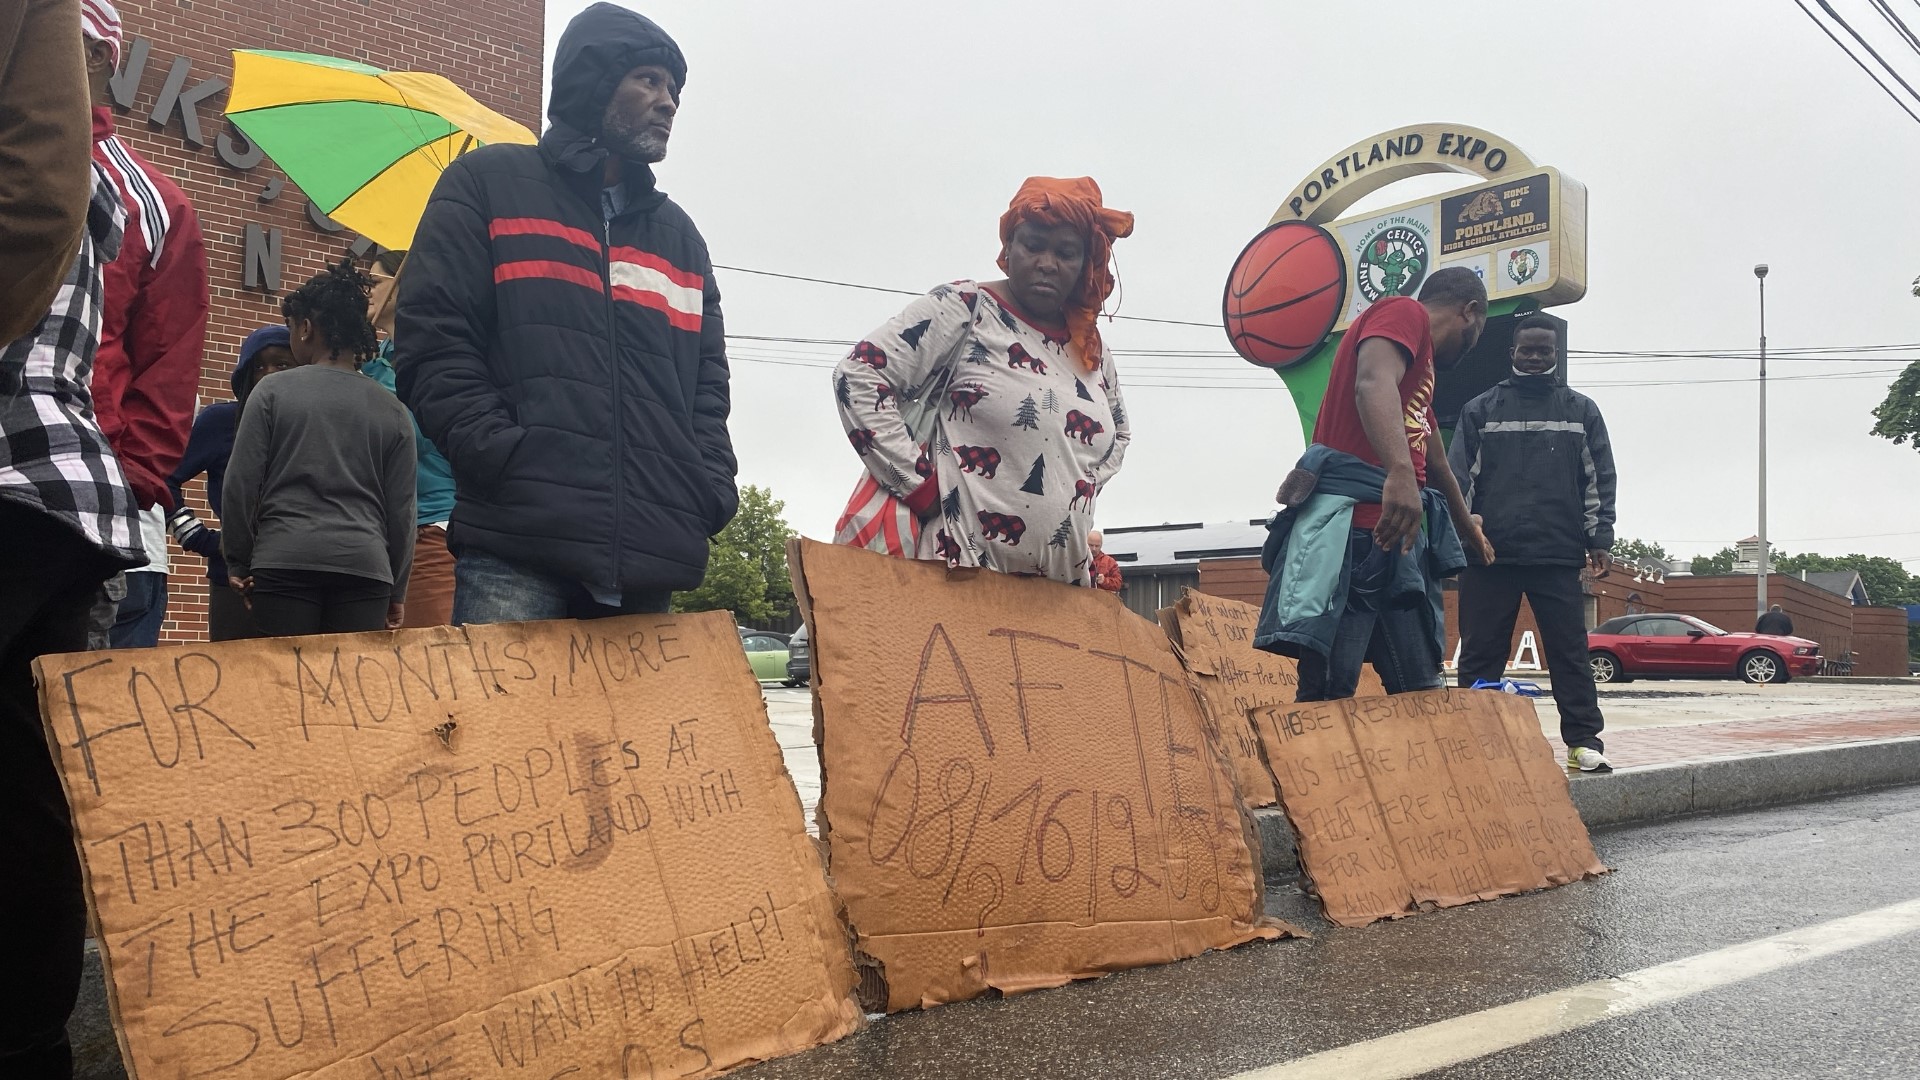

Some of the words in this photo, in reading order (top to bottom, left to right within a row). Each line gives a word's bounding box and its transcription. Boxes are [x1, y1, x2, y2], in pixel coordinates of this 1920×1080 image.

[1289, 133, 1424, 217] PORTLAND
[1437, 132, 1507, 173] EXPO
[1503, 186, 1530, 200] HOME
[1510, 198, 1523, 208] OF
[1355, 227, 1376, 253] HOME
[1377, 220, 1388, 230] OF
[1390, 216, 1406, 225] THE
[1407, 217, 1431, 237] MAINE
[1386, 229, 1425, 256] CELTICS
[1443, 241, 1464, 252] HIGH
[1465, 234, 1497, 247] SCHOOL
[1498, 222, 1547, 239] ATHLETICS
[1455, 212, 1535, 240] PORTLAND
[1359, 262, 1379, 301] MAINE
[1195, 596, 1212, 618] We
[1216, 604, 1251, 621] want
[1205, 617, 1223, 648] of
[1224, 623, 1249, 642] our
[1219, 655, 1251, 691] After
[1252, 662, 1279, 686] the
[62, 652, 256, 796] FOR
[568, 623, 690, 692] MORE
[1266, 704, 1334, 745] THOSE
[1286, 756, 1320, 797] US
[1332, 748, 1396, 784] HERE
[1407, 739, 1429, 772] AT
[1434, 736, 1474, 766] THE
[90, 816, 254, 905] THAN
[271, 792, 392, 854] 300
[665, 718, 699, 770] AT
[1303, 795, 1357, 848] THAT
[1358, 794, 1437, 835] THERE
[1442, 784, 1465, 819] IS
[1466, 783, 1491, 813] NO
[1322, 851, 1370, 886] FOR
[1370, 845, 1398, 871] US
[1400, 828, 1469, 867] THAT'S
[1472, 820, 1514, 853] WHY
[1514, 819, 1541, 847] WE
[120, 892, 275, 998] THE
[310, 852, 441, 928] EXPO
[463, 793, 651, 893] PORTLAND
[663, 768, 744, 830] WITH
[1343, 890, 1386, 917] AND
[162, 886, 561, 1076] SUFFERING
[482, 964, 596, 1069] WANT
[604, 956, 656, 1018] TO
[671, 891, 791, 1006] HELP!
